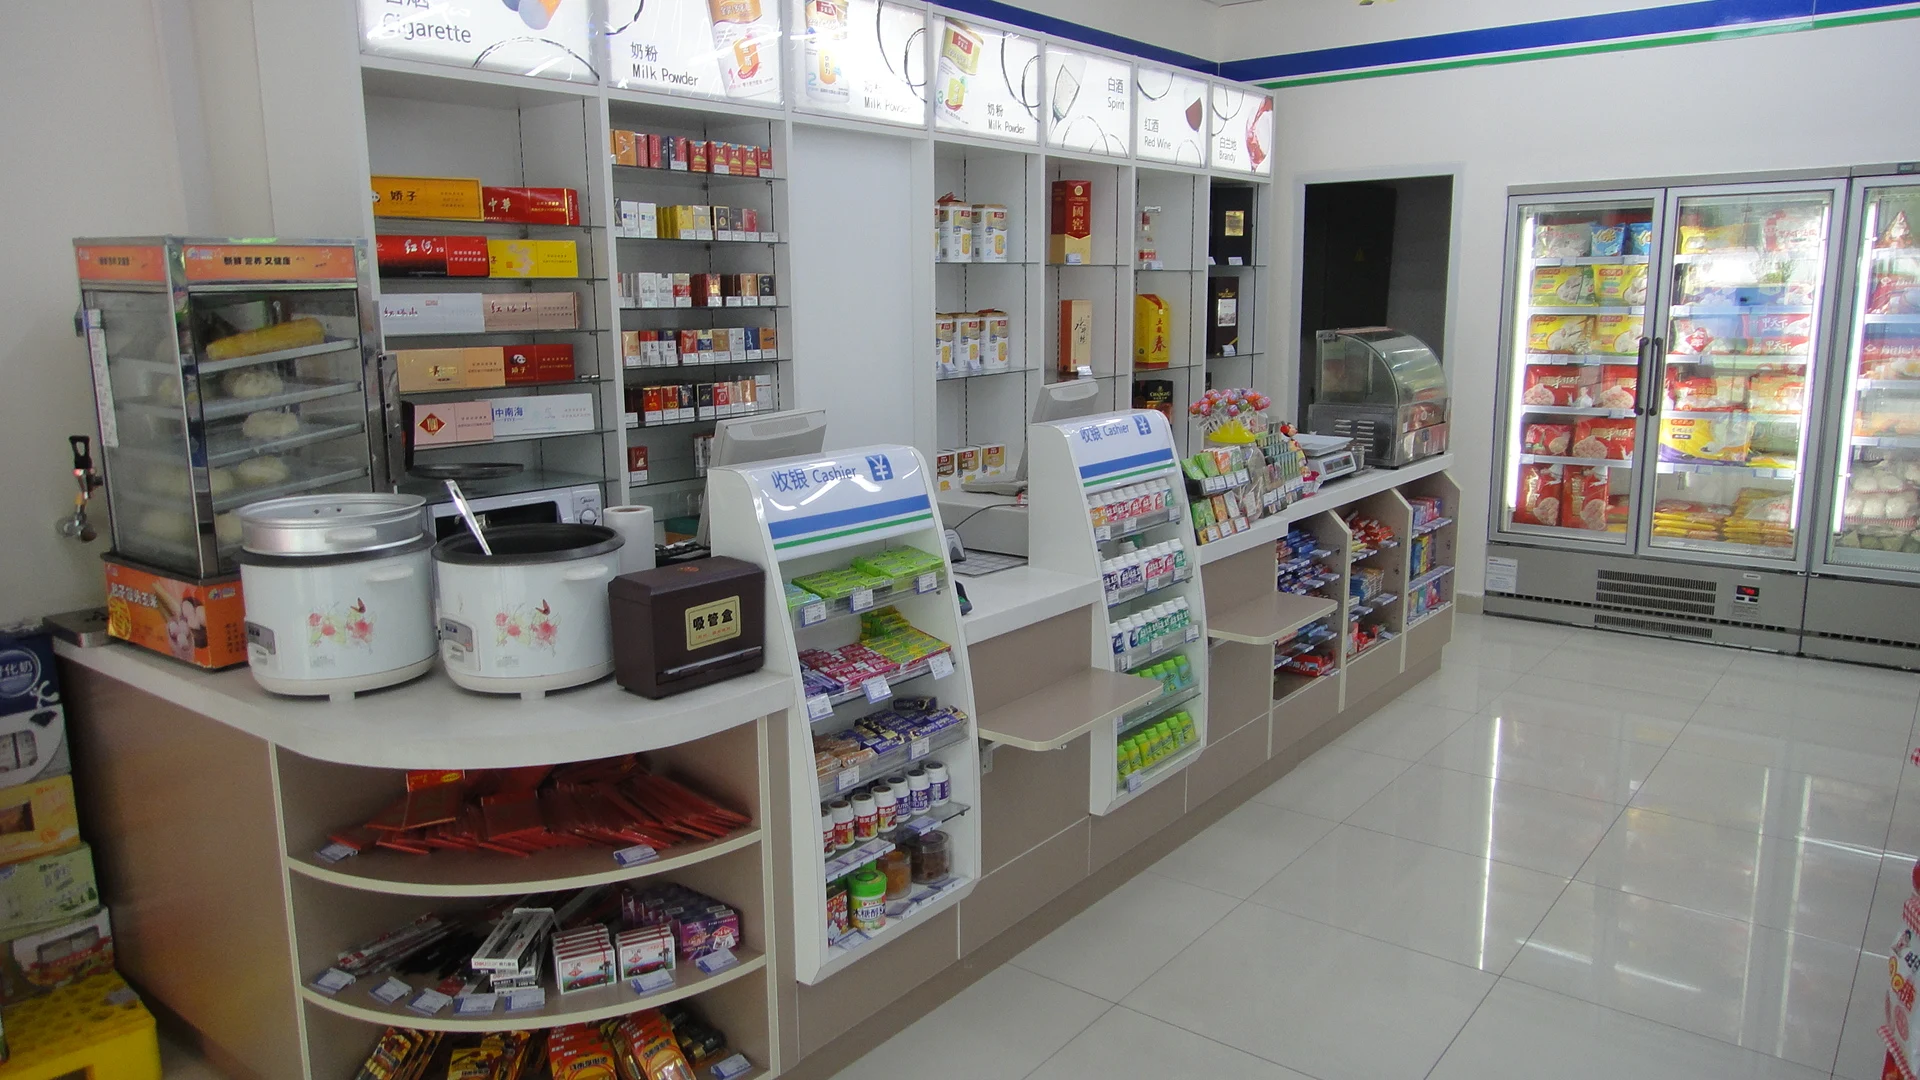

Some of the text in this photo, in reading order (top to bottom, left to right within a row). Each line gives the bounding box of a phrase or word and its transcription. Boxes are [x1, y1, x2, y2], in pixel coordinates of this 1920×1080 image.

[630, 41, 658, 63] 奶粉
[632, 63, 698, 87] Milk Powder
[1107, 76, 1124, 94] 白酒
[864, 96, 882, 110] Milk
[987, 102, 1004, 118] 奶粉
[1107, 96, 1125, 111] Spirit
[987, 119, 1026, 135] Milk Powder
[1144, 117, 1159, 133] 红酒
[1144, 136, 1172, 150] Red Wine
[1219, 136, 1237, 152] 白兰地
[1219, 150, 1236, 164] Brandy
[495, 407, 523, 417] 中南海
[1080, 425, 1103, 443] 收银
[1103, 423, 1130, 437] Cashier
[771, 468, 810, 492] 收银
[812, 465, 857, 484] Cashier
[693, 609, 733, 631] 吸管盒
